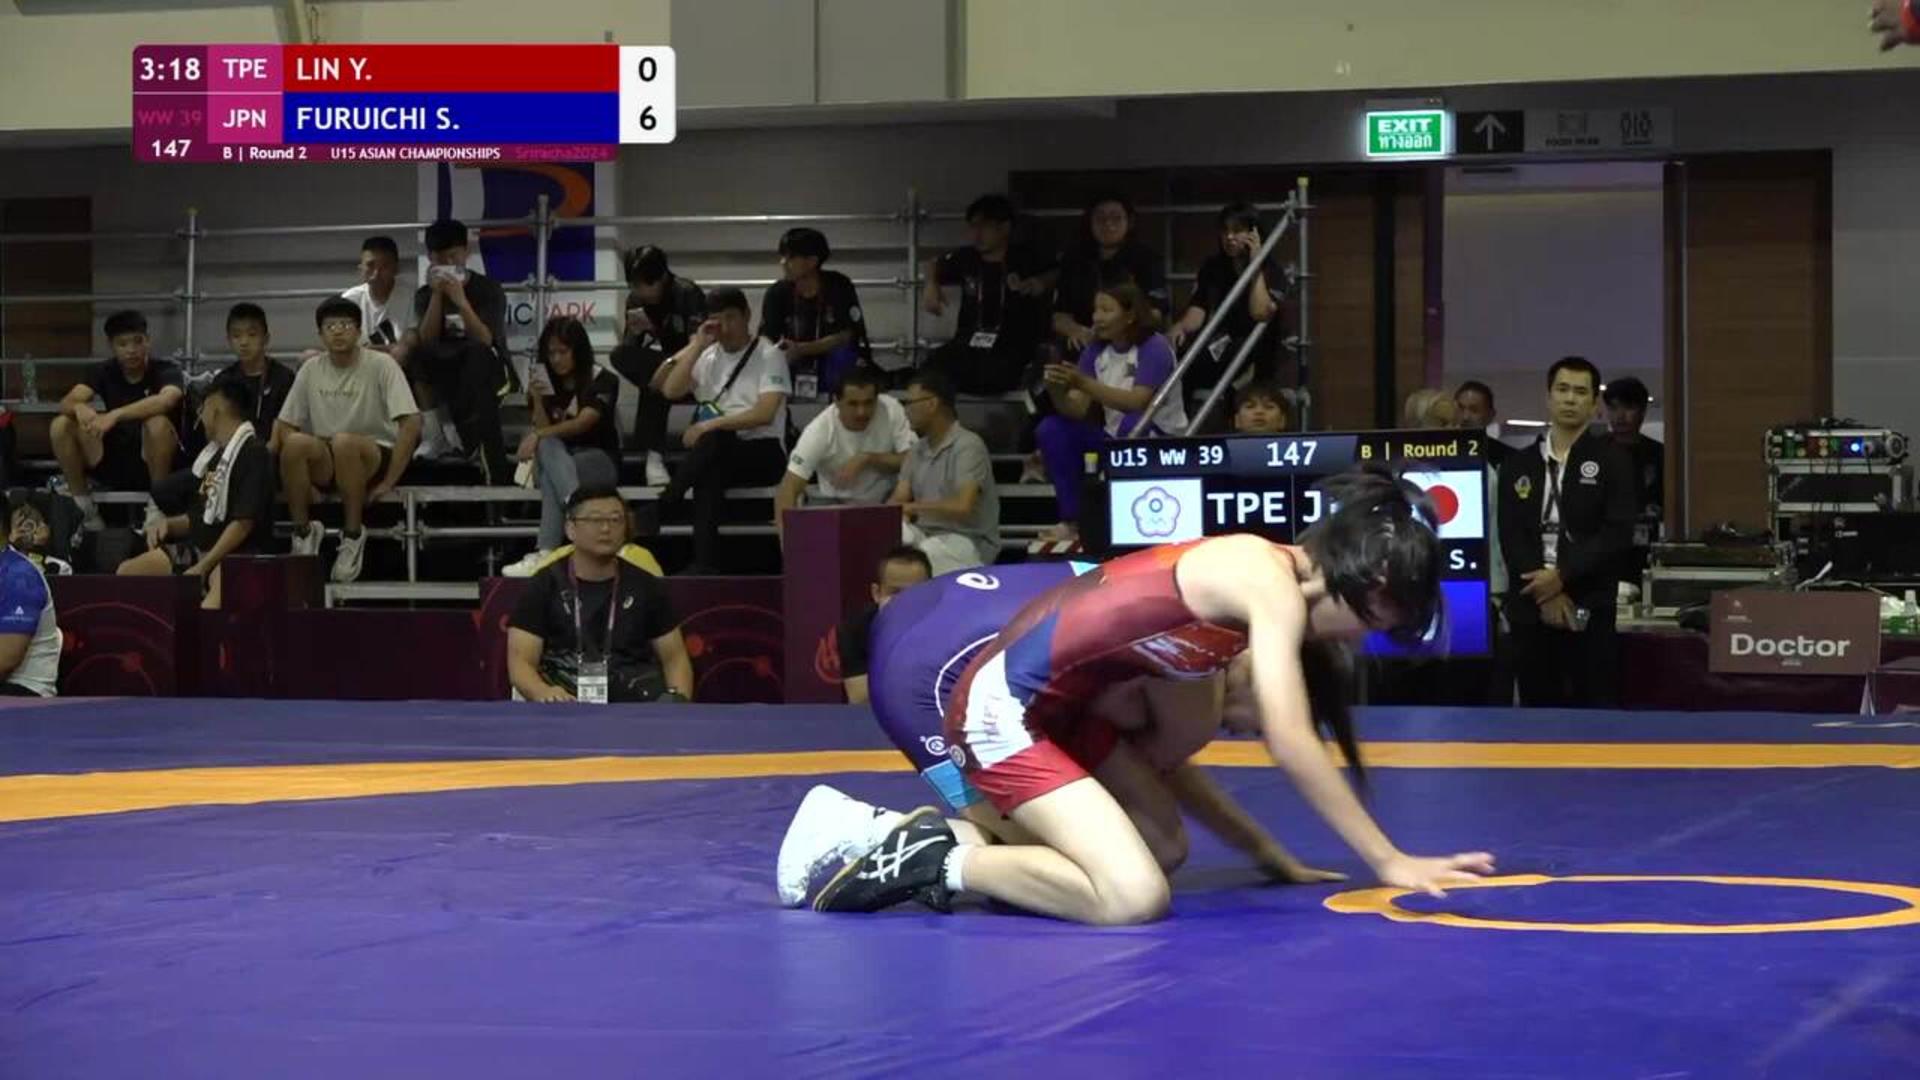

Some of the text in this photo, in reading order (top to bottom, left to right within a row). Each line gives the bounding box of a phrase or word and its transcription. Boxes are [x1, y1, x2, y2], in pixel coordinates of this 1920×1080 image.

[1378, 118, 1432, 133] EXIT
[1379, 134, 1432, 149] ทางออก
[1110, 446, 1224, 467] U15 WW 39
[1266, 442, 1318, 466] 147
[1361, 445, 1372, 459] B
[1403, 440, 1458, 458] Round
[1467, 440, 1479, 456] 2
[1207, 492, 1287, 524] TPE
[1449, 549, 1478, 570] S.
[1730, 633, 1850, 657] Doctor
